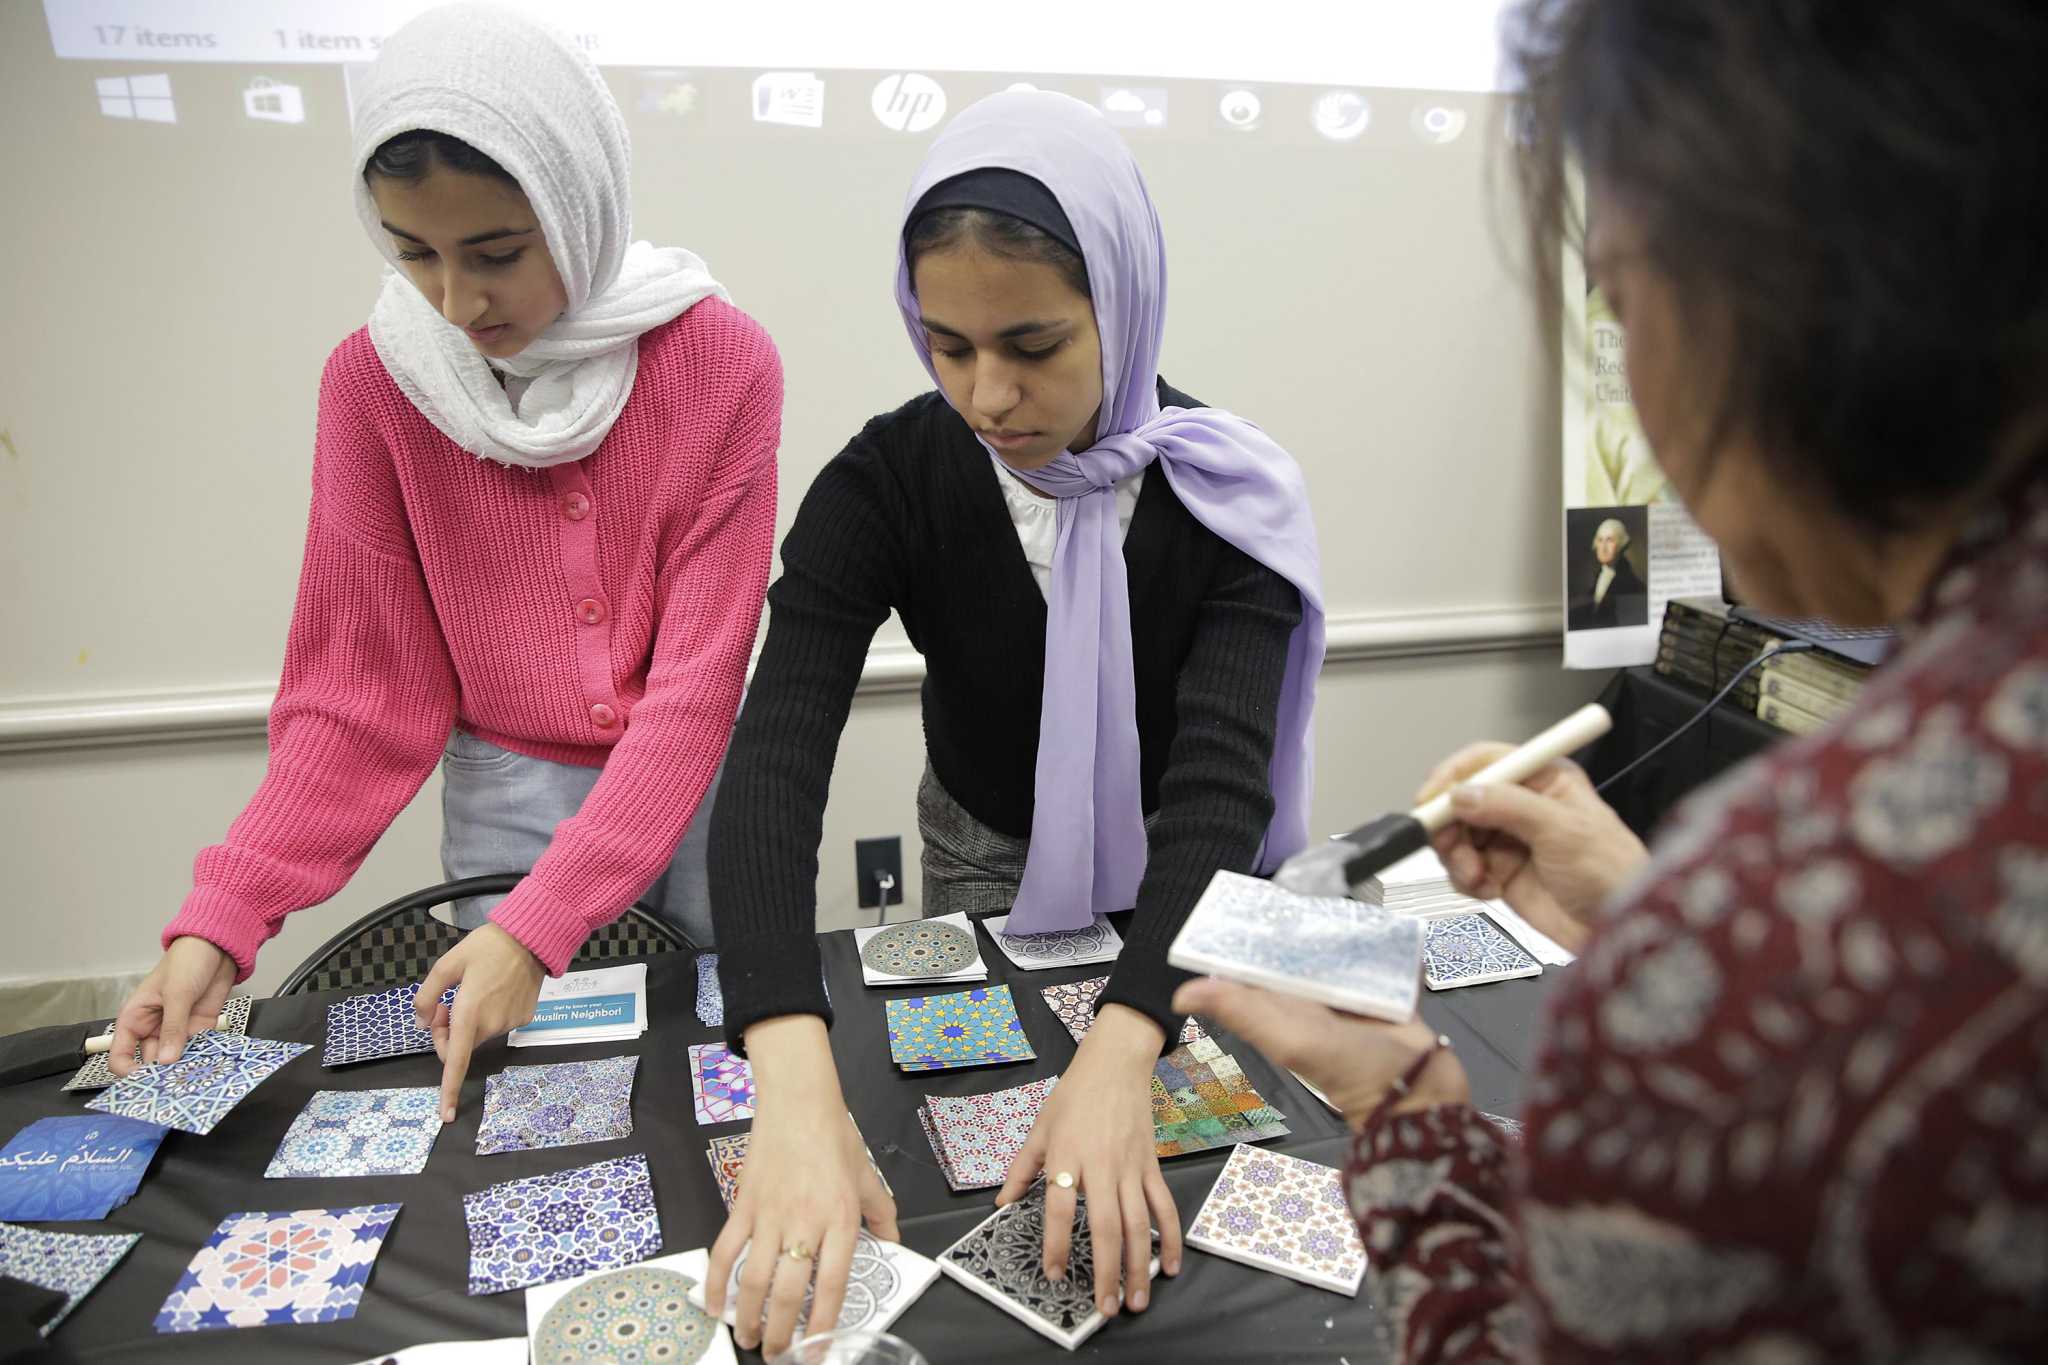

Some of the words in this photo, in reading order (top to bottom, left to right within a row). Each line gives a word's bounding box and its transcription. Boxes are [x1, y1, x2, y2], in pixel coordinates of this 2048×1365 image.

[93, 25, 127, 46] 17
[135, 25, 218, 48] items
[273, 28, 288, 49] 1
[297, 28, 361, 49] item
[1595, 383, 1632, 403] Unit
[532, 1011, 568, 1022] Muslim
[571, 1007, 622, 1020] Neighbor!
